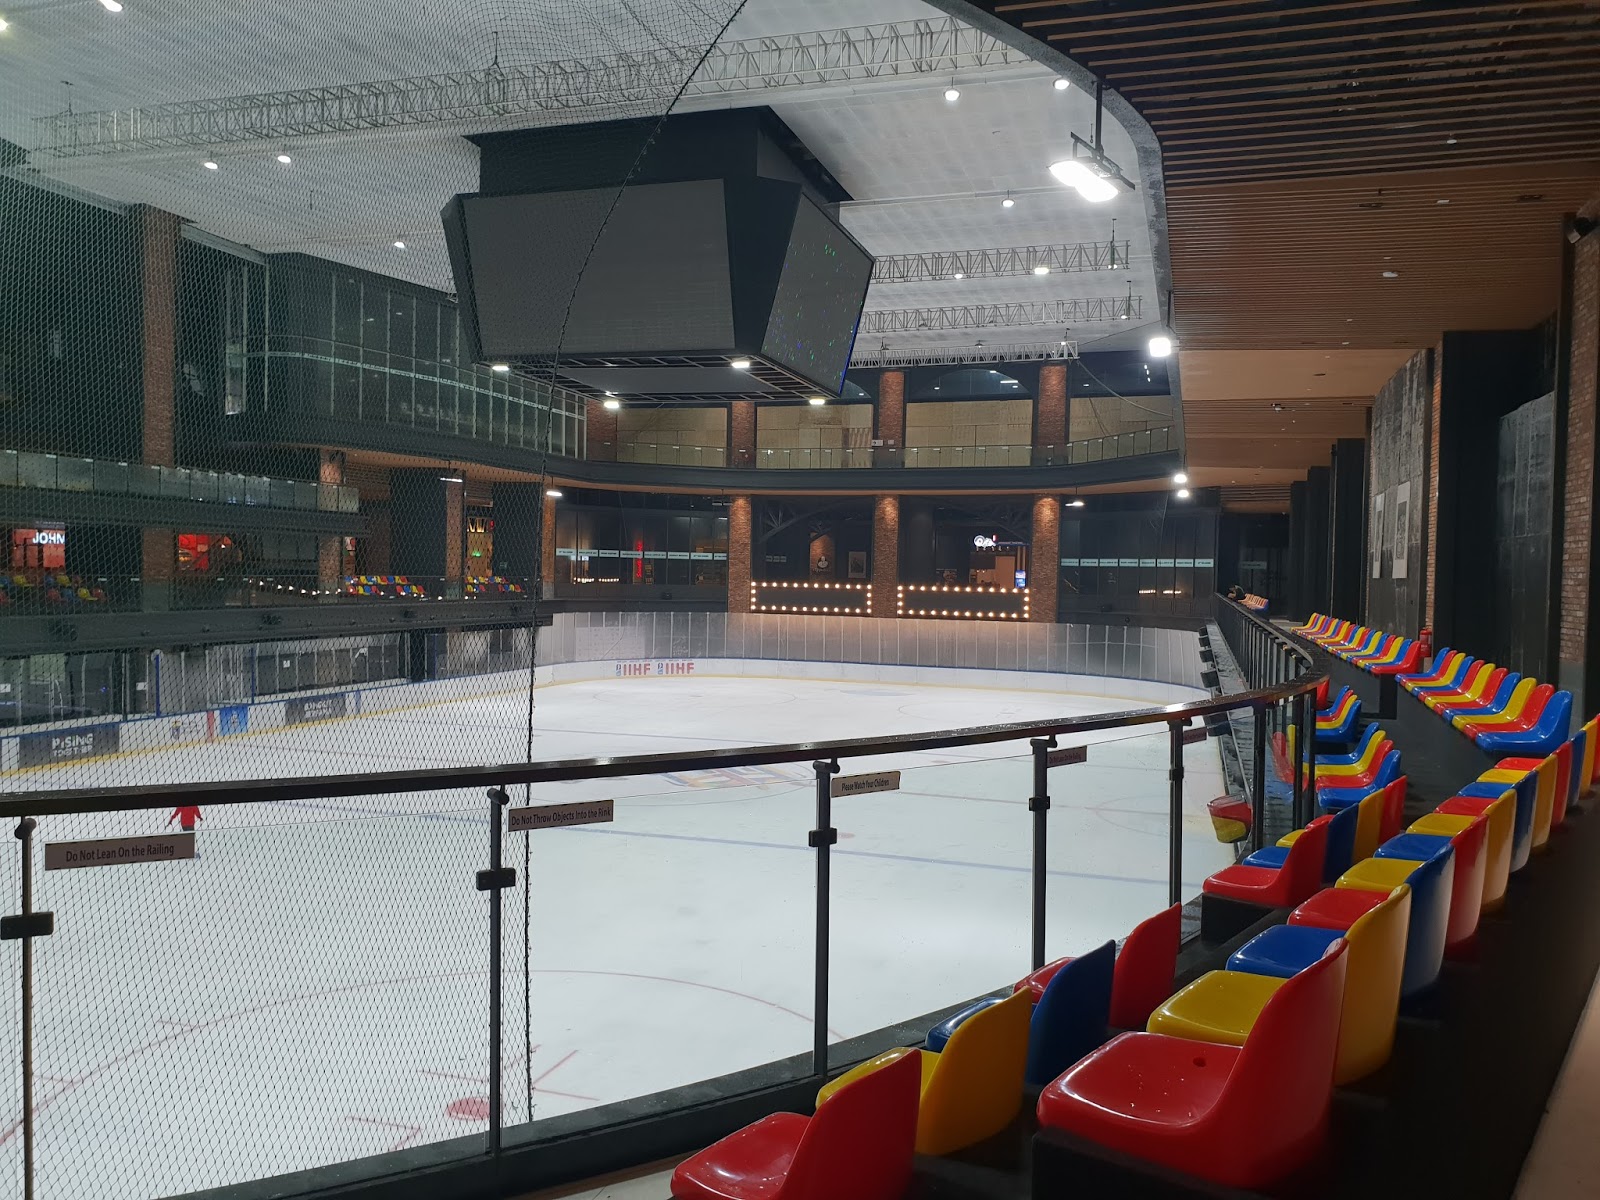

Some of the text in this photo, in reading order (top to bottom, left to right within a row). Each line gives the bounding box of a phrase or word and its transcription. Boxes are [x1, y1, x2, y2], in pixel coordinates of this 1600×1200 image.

[623, 662, 695, 676] IIHF IIHF
[841, 783, 854, 791] Please
[511, 807, 611, 826] Do Not Throw Objects Into the Rink
[66, 844, 174, 862] Do Not Lean On the Railing
